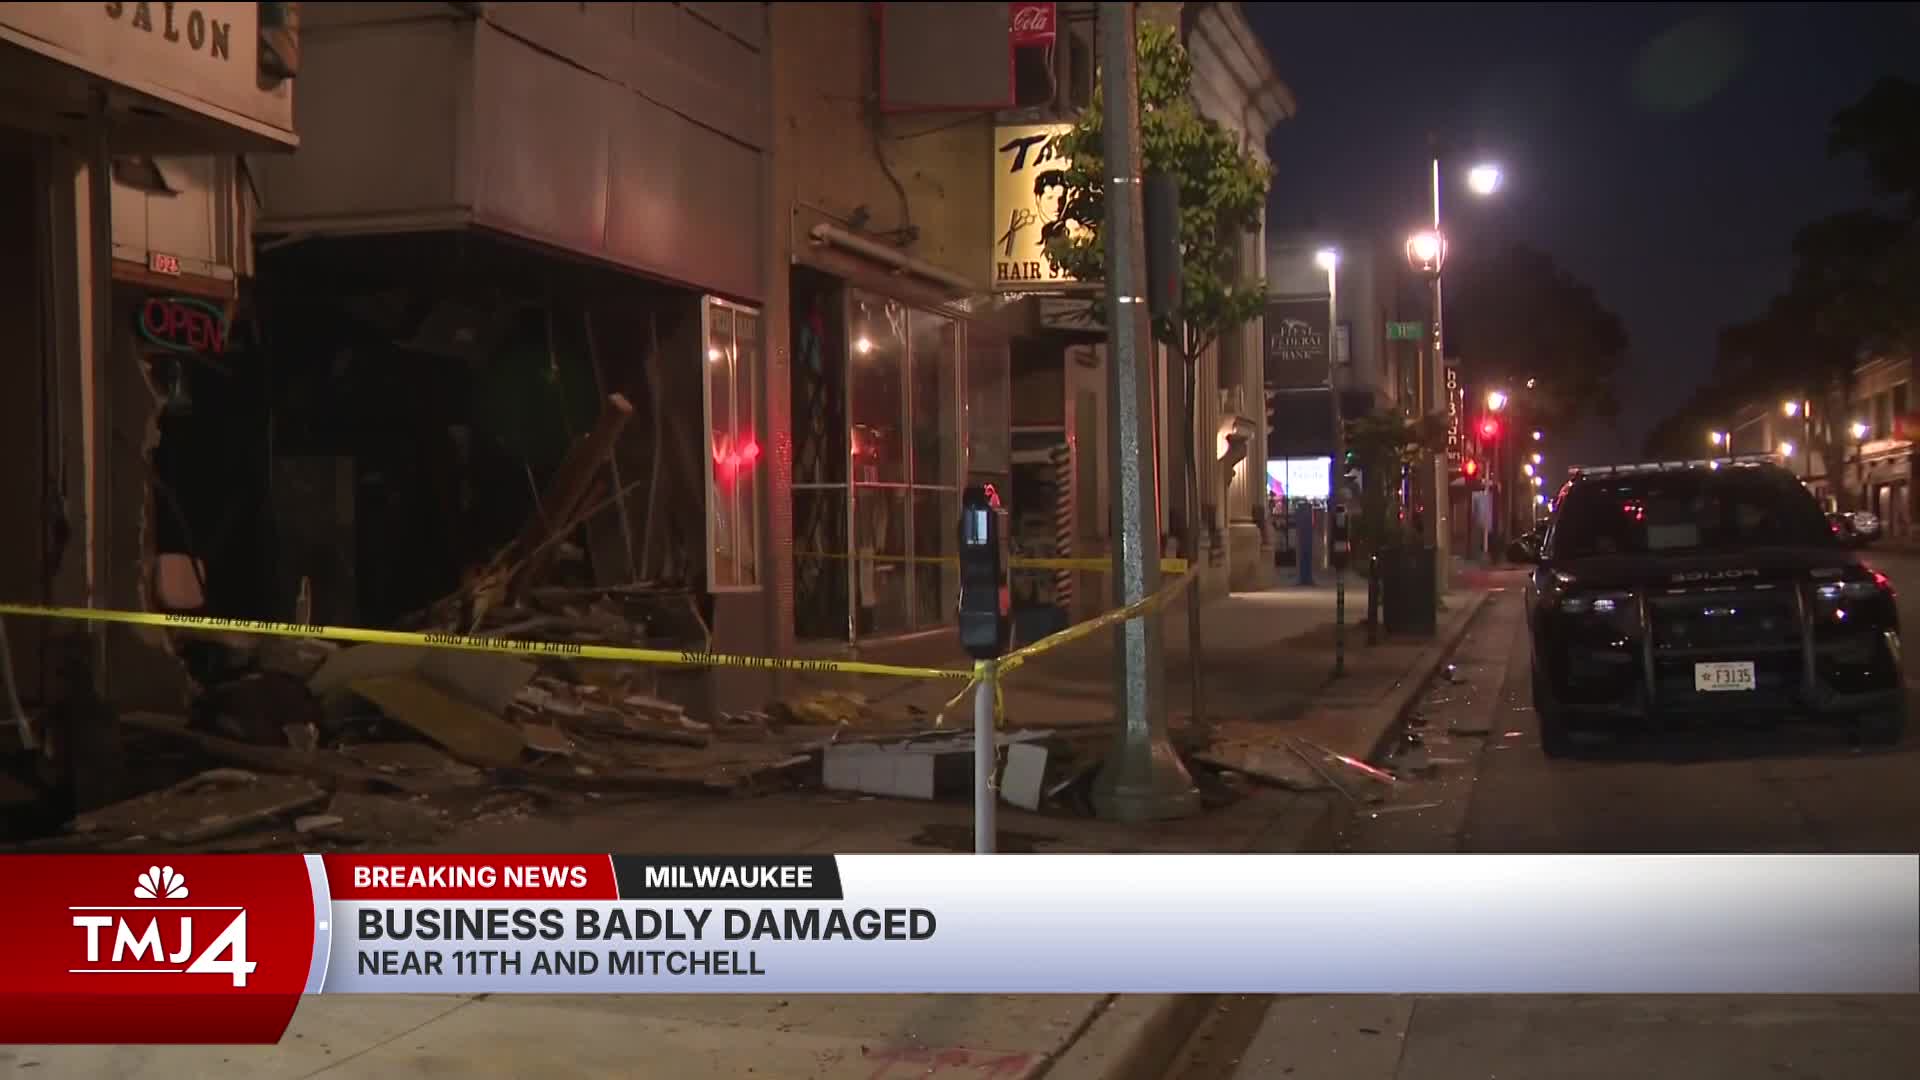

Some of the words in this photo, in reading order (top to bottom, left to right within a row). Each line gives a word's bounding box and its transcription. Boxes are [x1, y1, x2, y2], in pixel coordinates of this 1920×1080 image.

[1013, 6, 1049, 32] Cola
[997, 261, 1042, 280] HAIR
[144, 298, 225, 352] OPEN
[1271, 336, 1321, 349] FEDERAL
[1281, 350, 1313, 361] BANK
[1716, 669, 1752, 684] F3135
